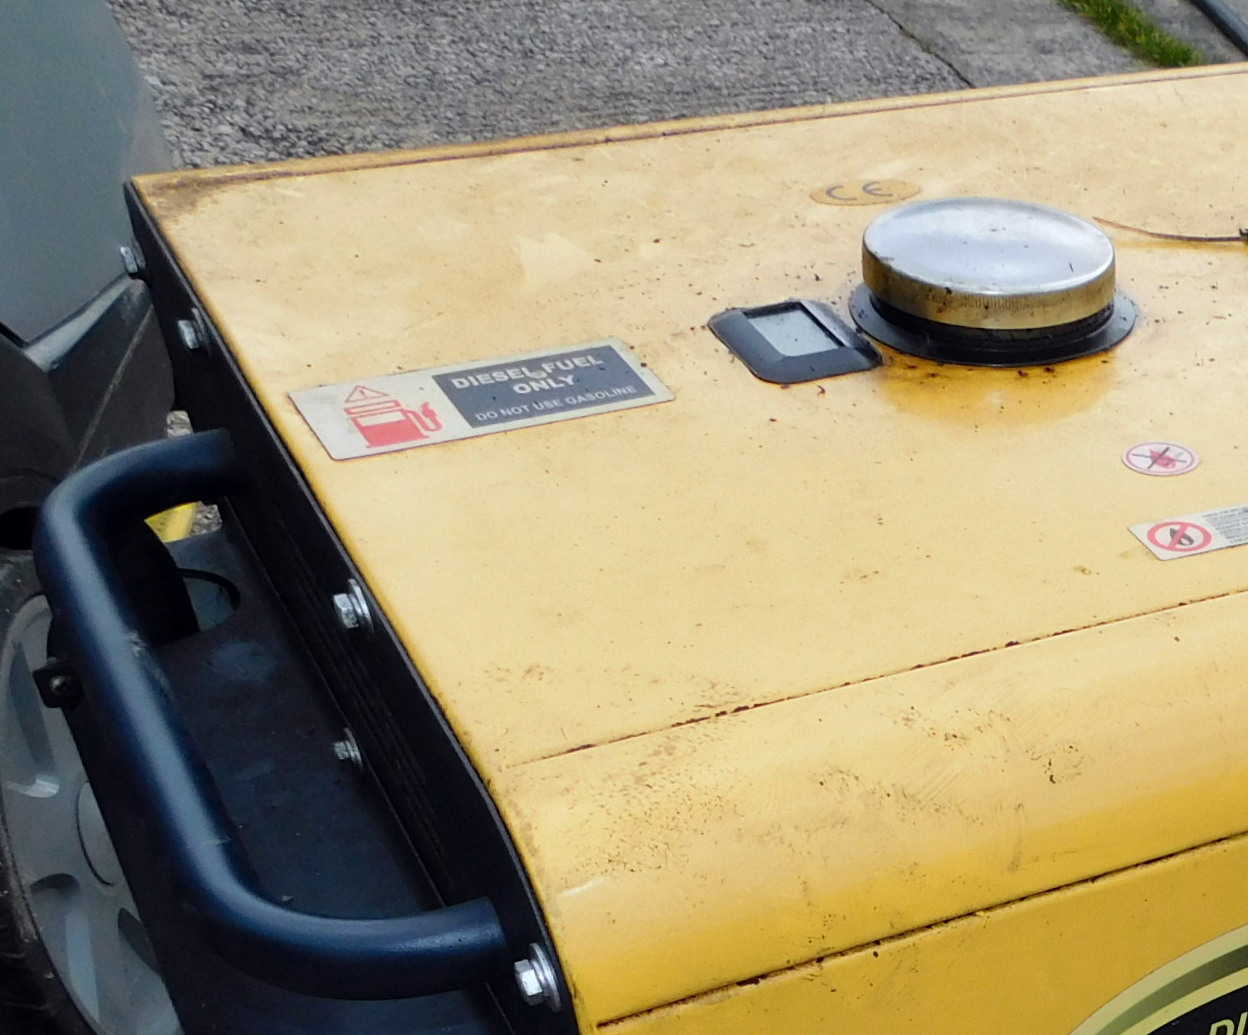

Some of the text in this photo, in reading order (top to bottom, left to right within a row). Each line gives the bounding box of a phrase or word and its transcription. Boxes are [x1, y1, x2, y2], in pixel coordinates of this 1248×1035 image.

[825, 181, 894, 201] CE
[452, 355, 604, 390] DIESEL FUEL
[513, 374, 575, 394] ONLY
[475, 385, 637, 421] DO NOT USE GASOLINE
